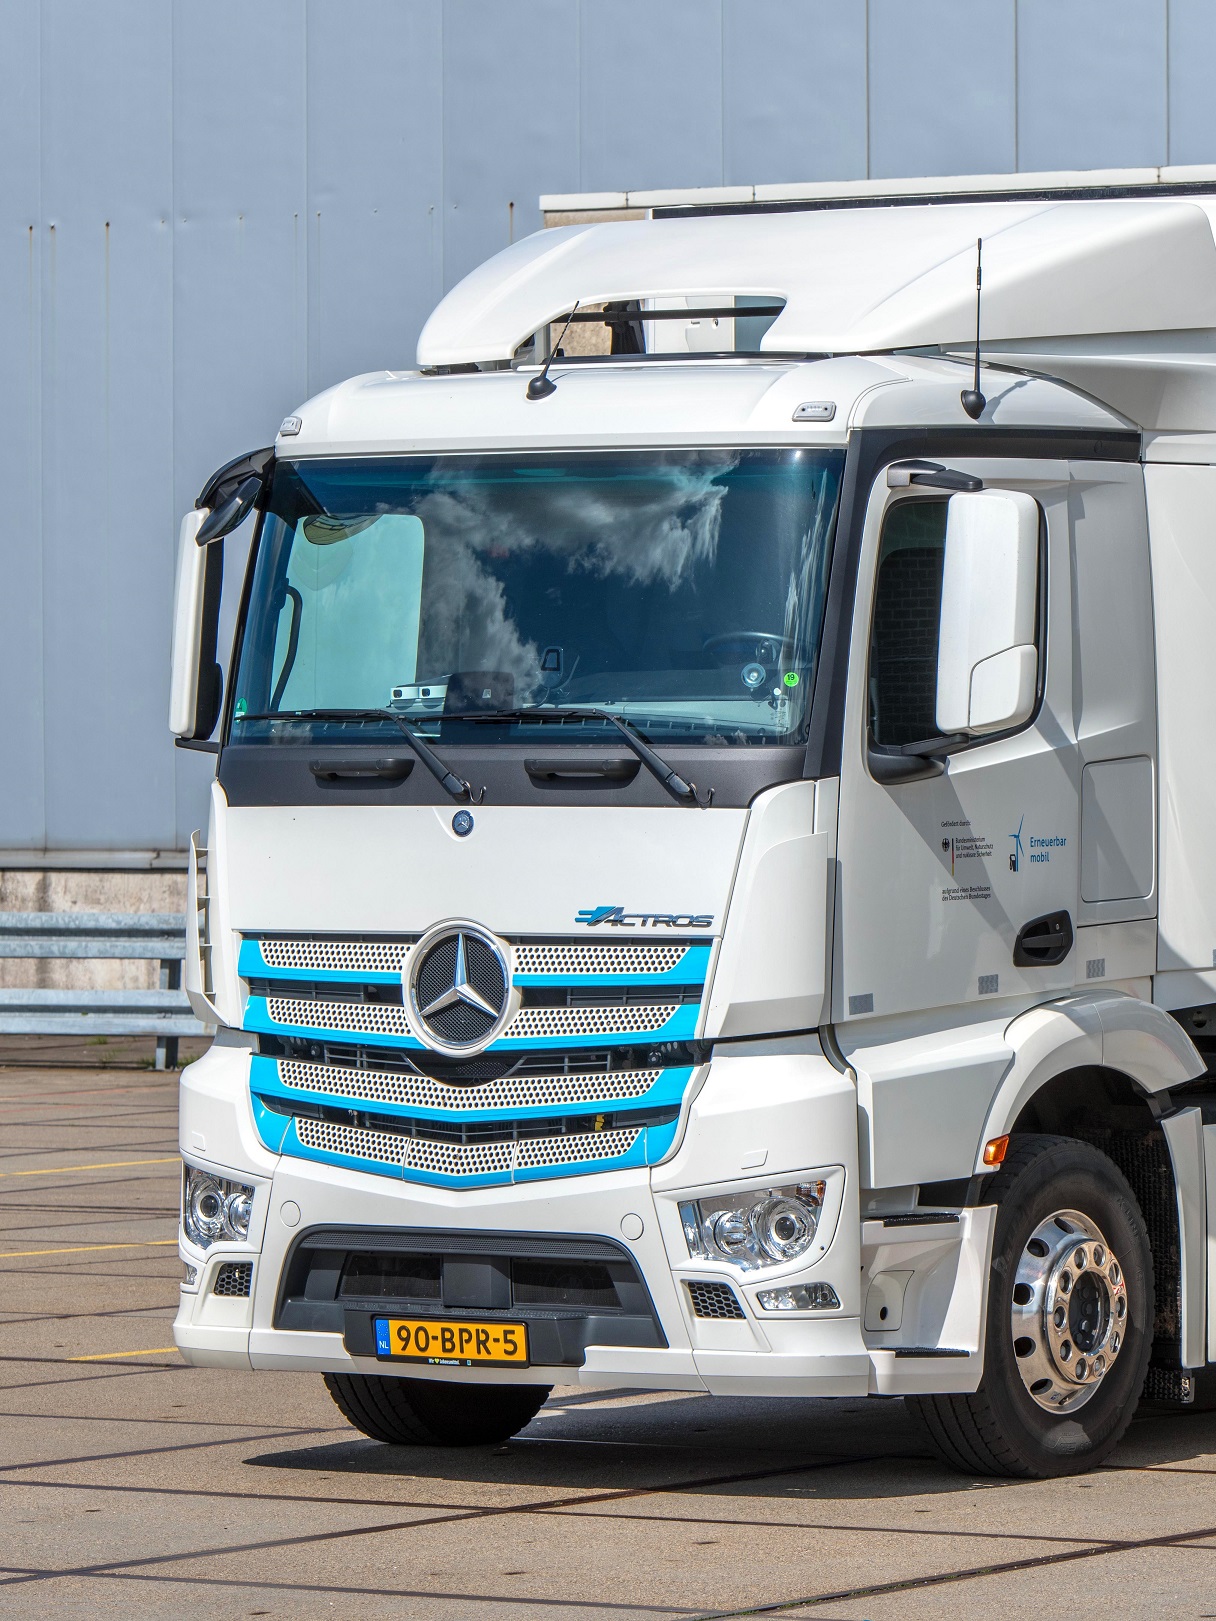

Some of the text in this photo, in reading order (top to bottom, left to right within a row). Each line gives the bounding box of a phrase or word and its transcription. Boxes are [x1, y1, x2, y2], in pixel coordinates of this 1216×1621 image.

[1030, 836, 1067, 848] Erneuerbar
[1030, 852, 1050, 862] mobil
[396, 1325, 518, 1356] 90-BPR-5
